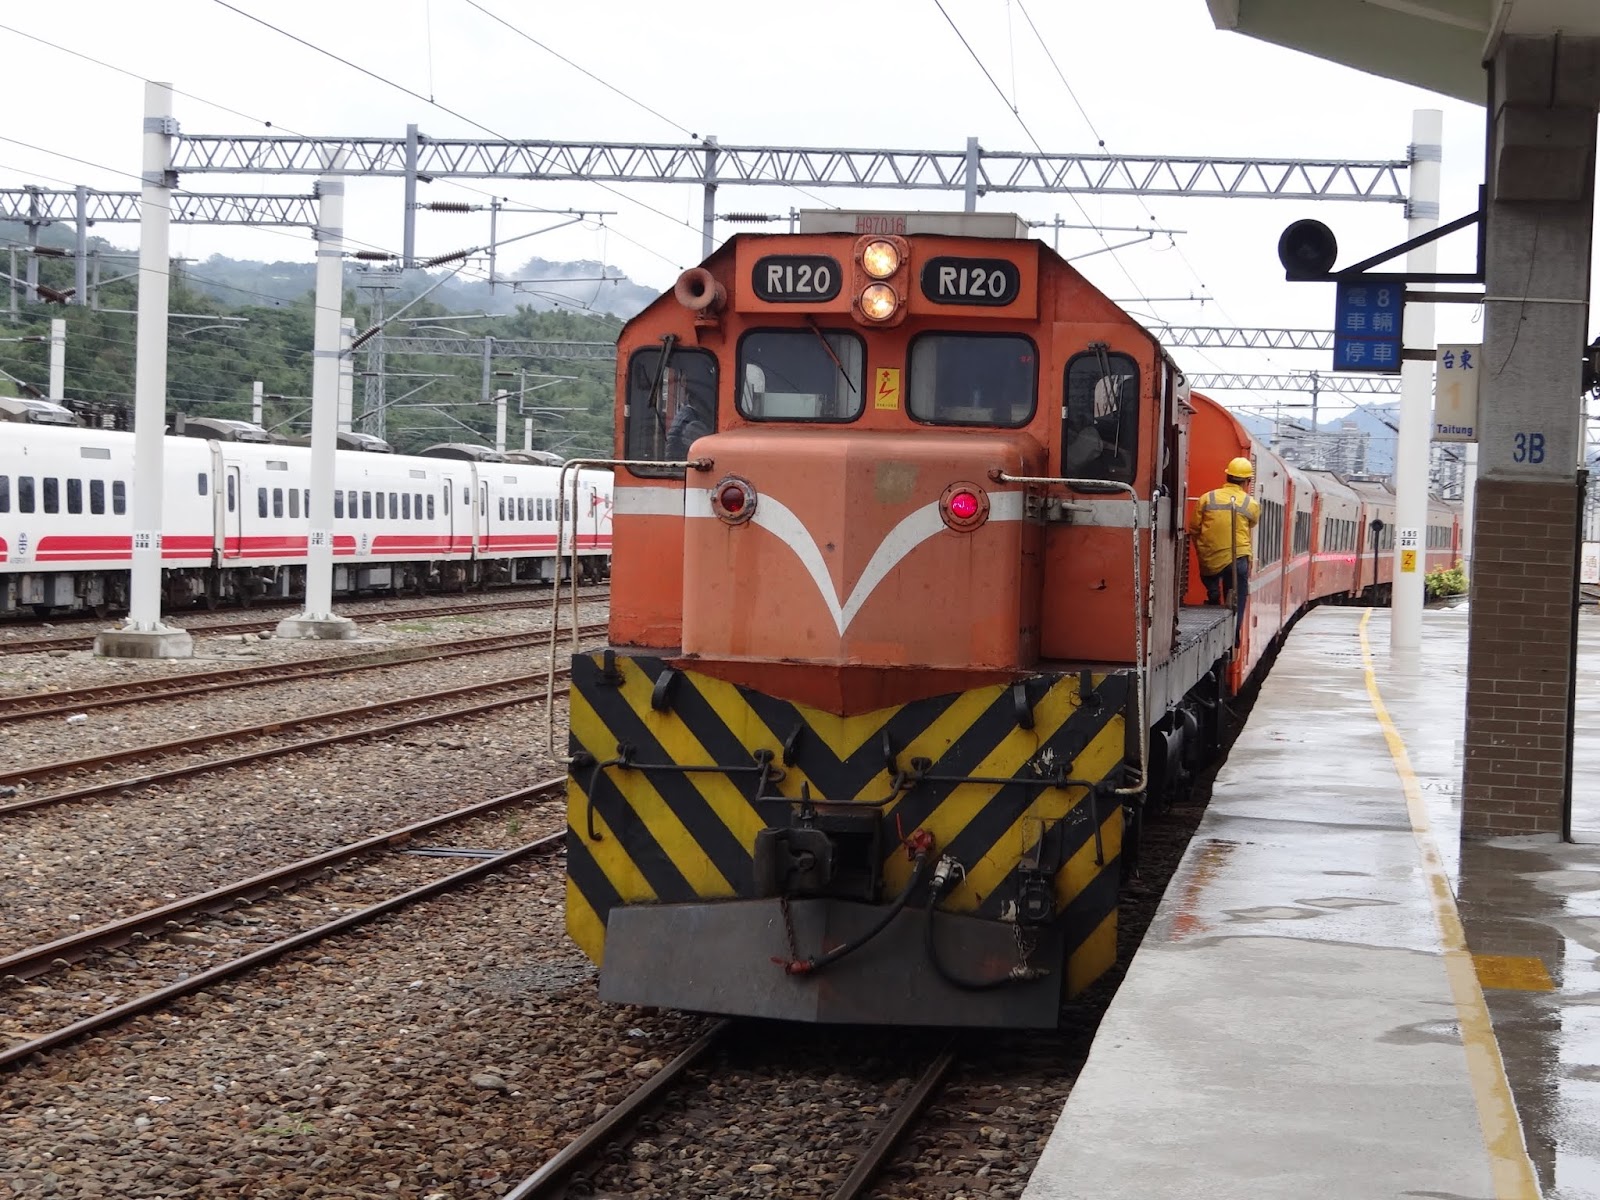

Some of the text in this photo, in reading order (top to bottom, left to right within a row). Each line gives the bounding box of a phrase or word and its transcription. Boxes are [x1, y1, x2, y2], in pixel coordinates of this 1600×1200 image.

[767, 264, 830, 293] R120
[939, 266, 1006, 298] R120
[1345, 342, 1393, 363] 停車
[1442, 349, 1473, 370] 台東
[1437, 424, 1473, 436] Taitung
[1513, 432, 1545, 464] 3B
